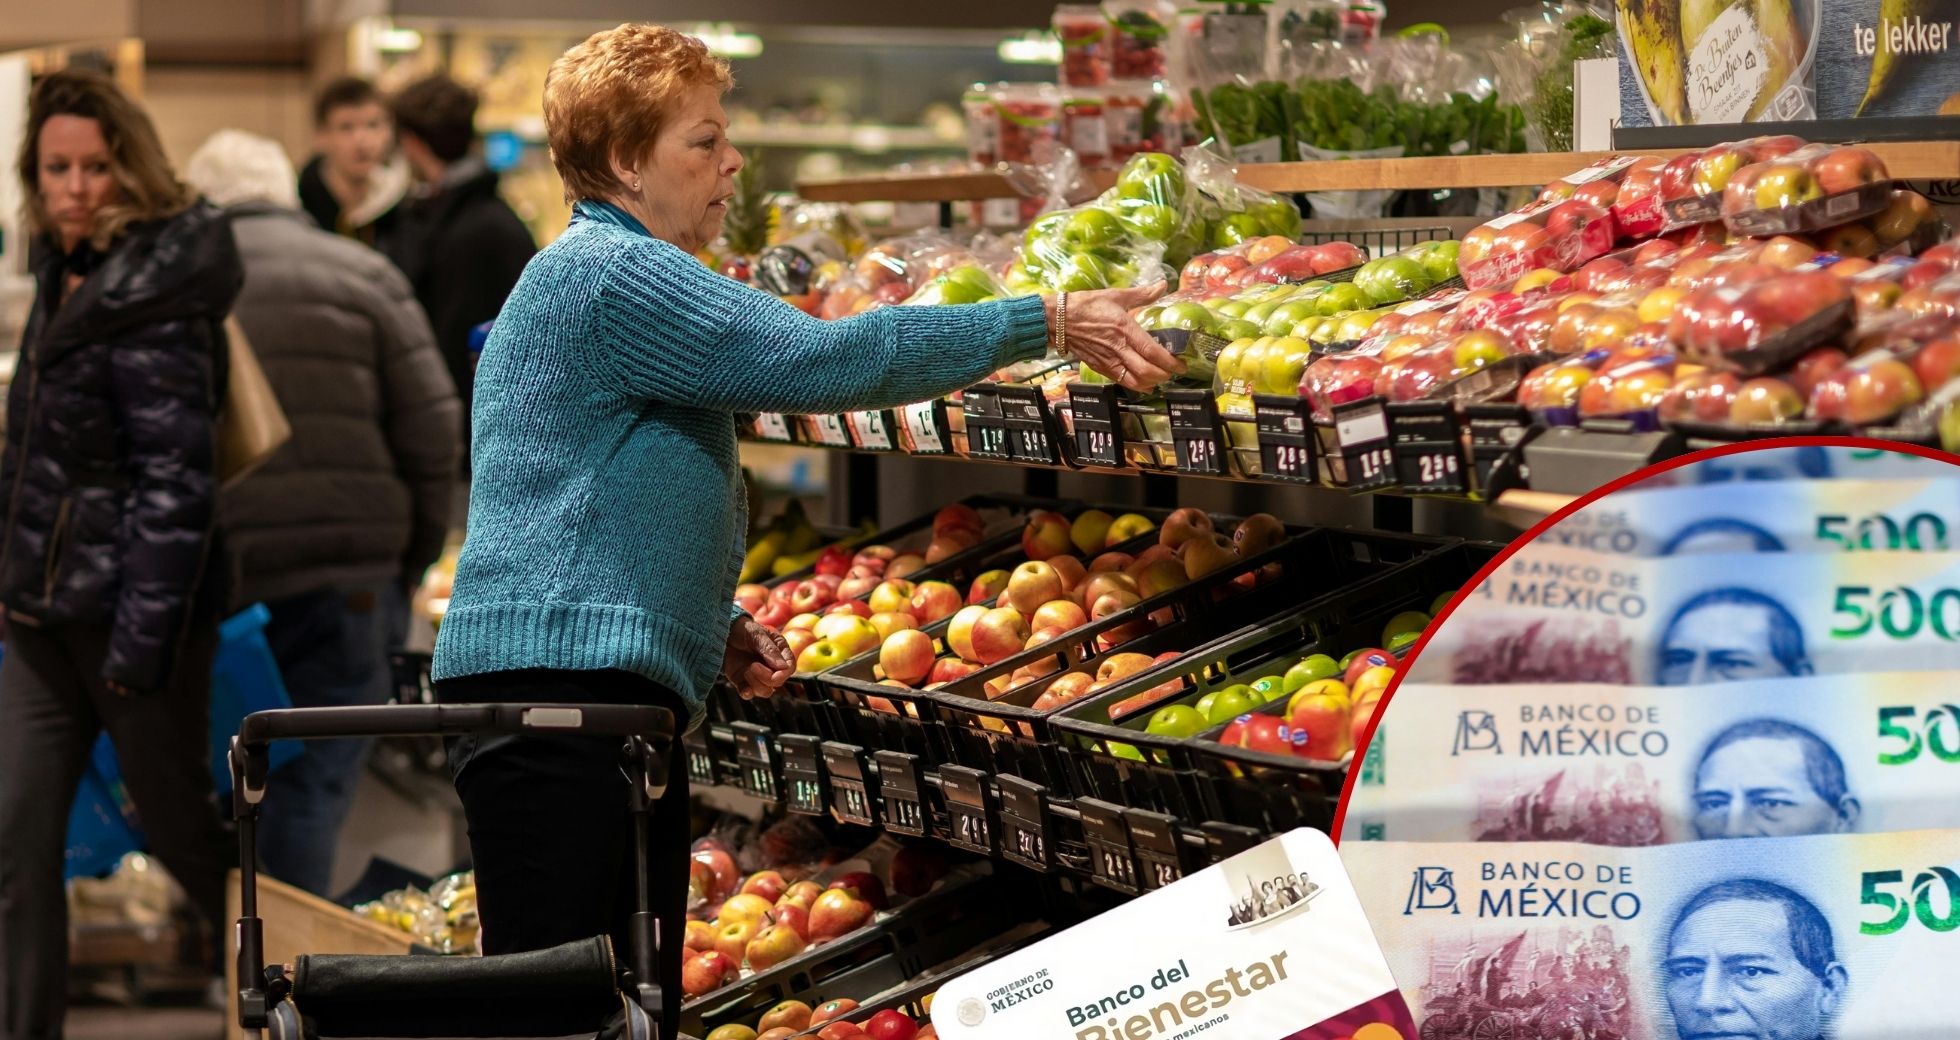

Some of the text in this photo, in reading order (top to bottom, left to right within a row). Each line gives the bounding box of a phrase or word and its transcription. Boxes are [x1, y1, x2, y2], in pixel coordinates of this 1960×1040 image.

[1706, 24, 1742, 74] Buiten
[1854, 15, 1952, 55] te lekker
[1698, 53, 1743, 111] Beentjes
[1513, 560, 1640, 588] BANCO DE
[1508, 581, 1646, 618] MÉXICO
[1829, 586, 1960, 640] 500
[1520, 704, 1660, 723] BANCO DE
[1520, 724, 1669, 757] MÉXICO
[1877, 703, 1960, 766] 50
[1481, 861, 1633, 884] BANCO DE
[1478, 882, 1641, 920] MÉXICO
[1859, 866, 1960, 935] 50
[986, 968, 1050, 1001] GOBIERNO DE
[990, 978, 1054, 1014] MÉXICO
[1065, 958, 1191, 1028] Banco del
[1075, 949, 1289, 1040] Bienestar
[1172, 1013, 1231, 1040] mexicanos
